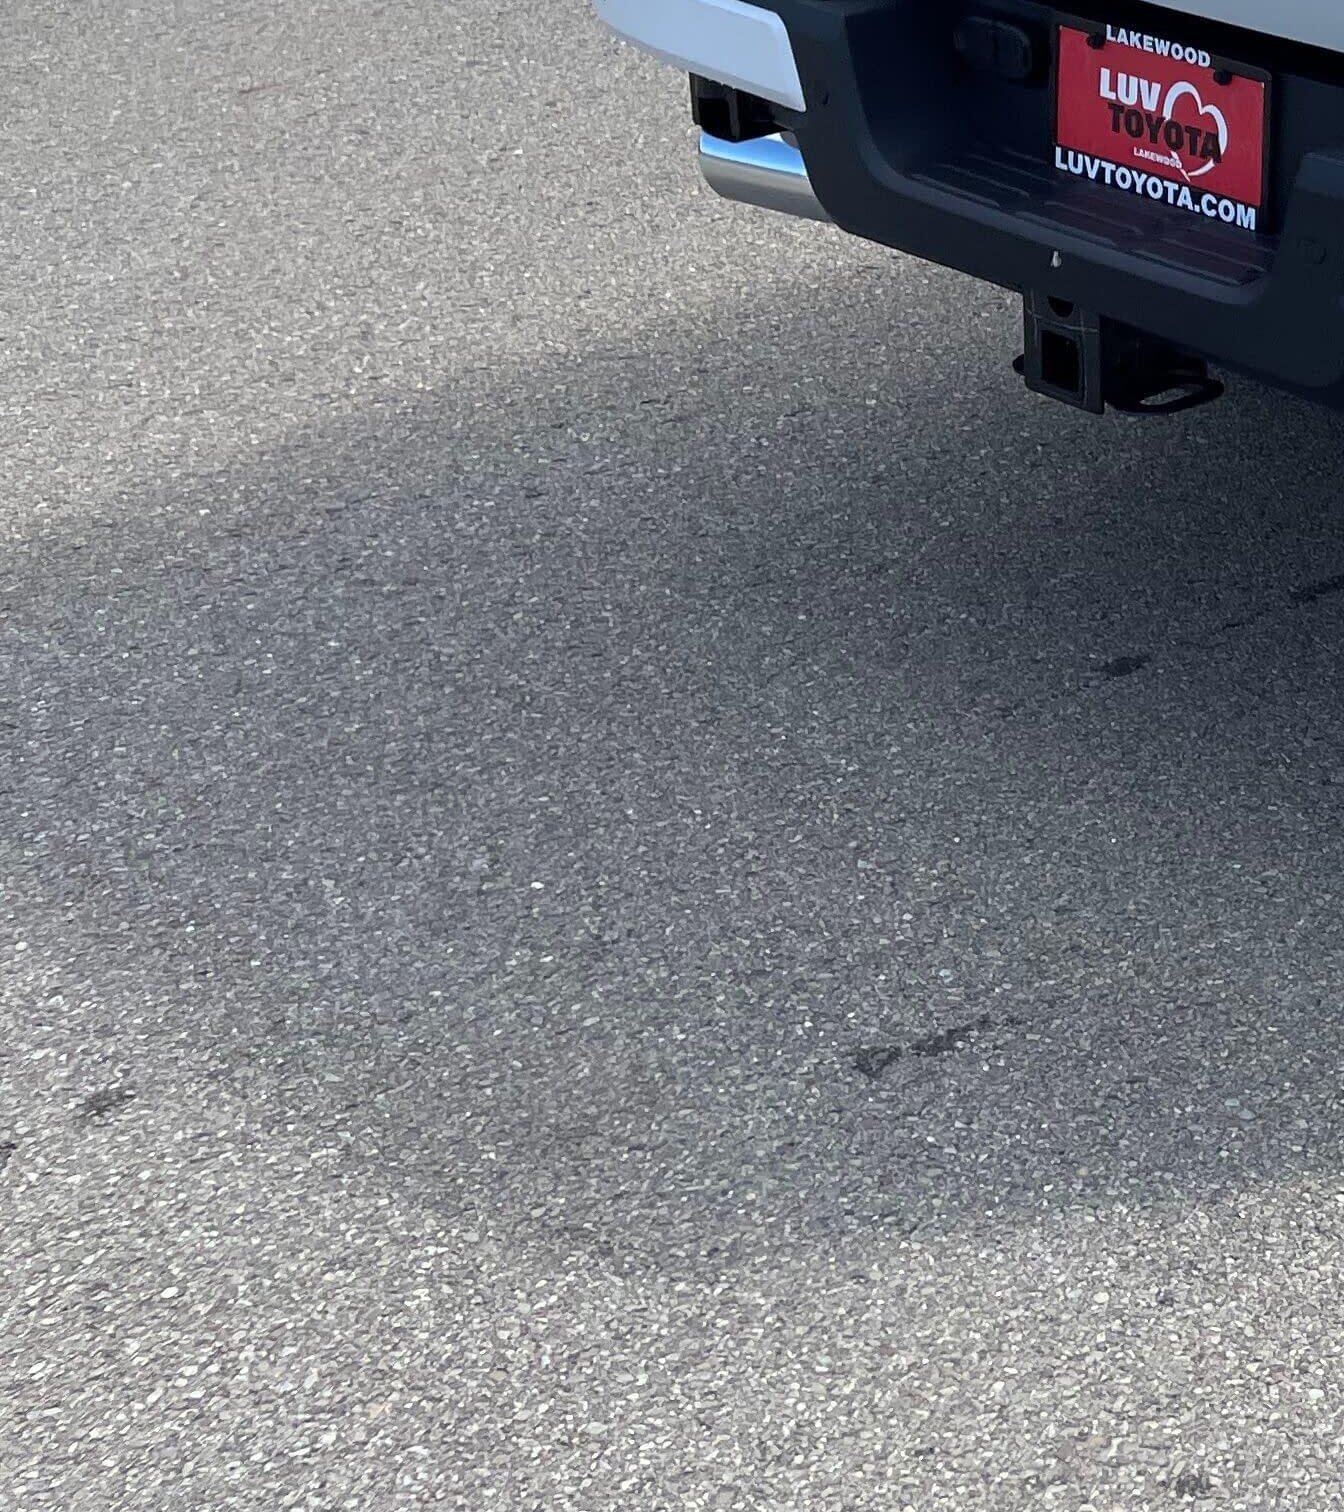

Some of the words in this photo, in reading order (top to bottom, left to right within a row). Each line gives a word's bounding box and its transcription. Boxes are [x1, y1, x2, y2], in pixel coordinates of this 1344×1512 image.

[1105, 24, 1211, 68] LAKEWOOD
[1099, 67, 1162, 112] LUV
[1107, 102, 1222, 164] TOYOTA
[1133, 146, 1183, 170] LAKEWOOD
[1055, 146, 1257, 231] LUVTOYOTA.COM
